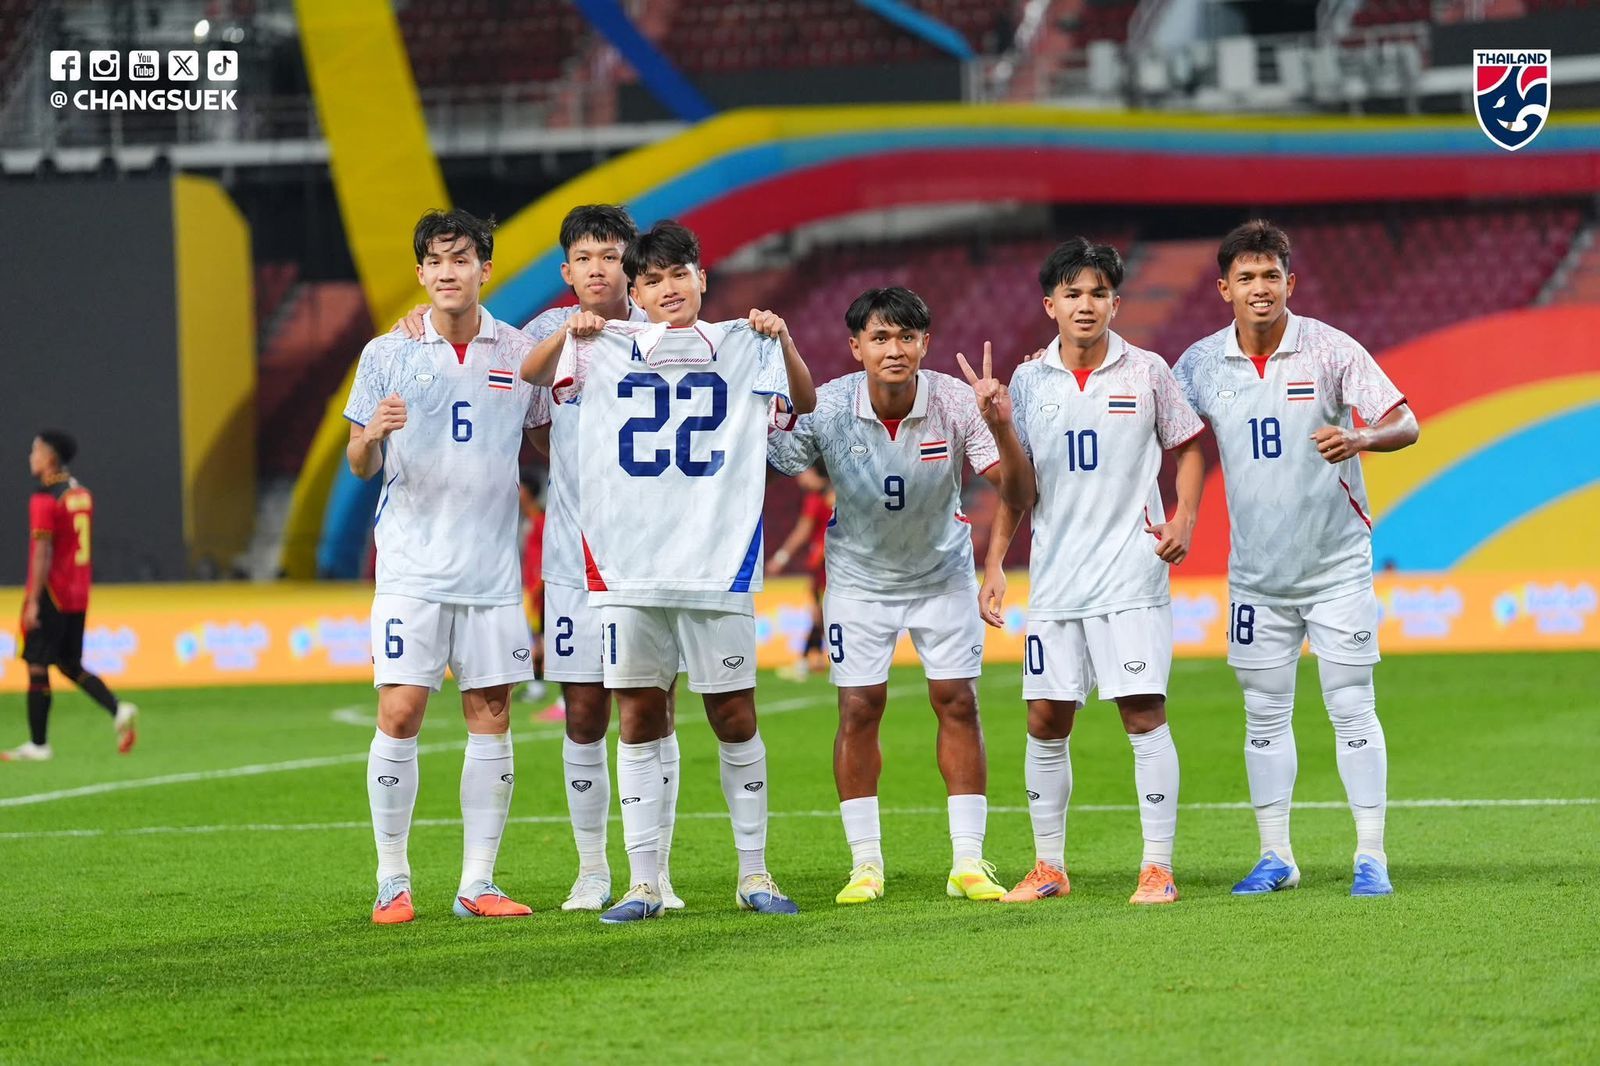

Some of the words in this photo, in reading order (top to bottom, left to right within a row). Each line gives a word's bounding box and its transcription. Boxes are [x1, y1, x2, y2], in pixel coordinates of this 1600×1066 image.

[451, 401, 473, 443] 6
[617, 372, 728, 477] 22
[1248, 418, 1282, 460] 18
[1065, 430, 1098, 472] 10
[884, 475, 905, 511] 9
[385, 618, 404, 659] 6
[555, 616, 574, 657] 2
[829, 623, 845, 664] 9
[1230, 602, 1255, 645] 18
